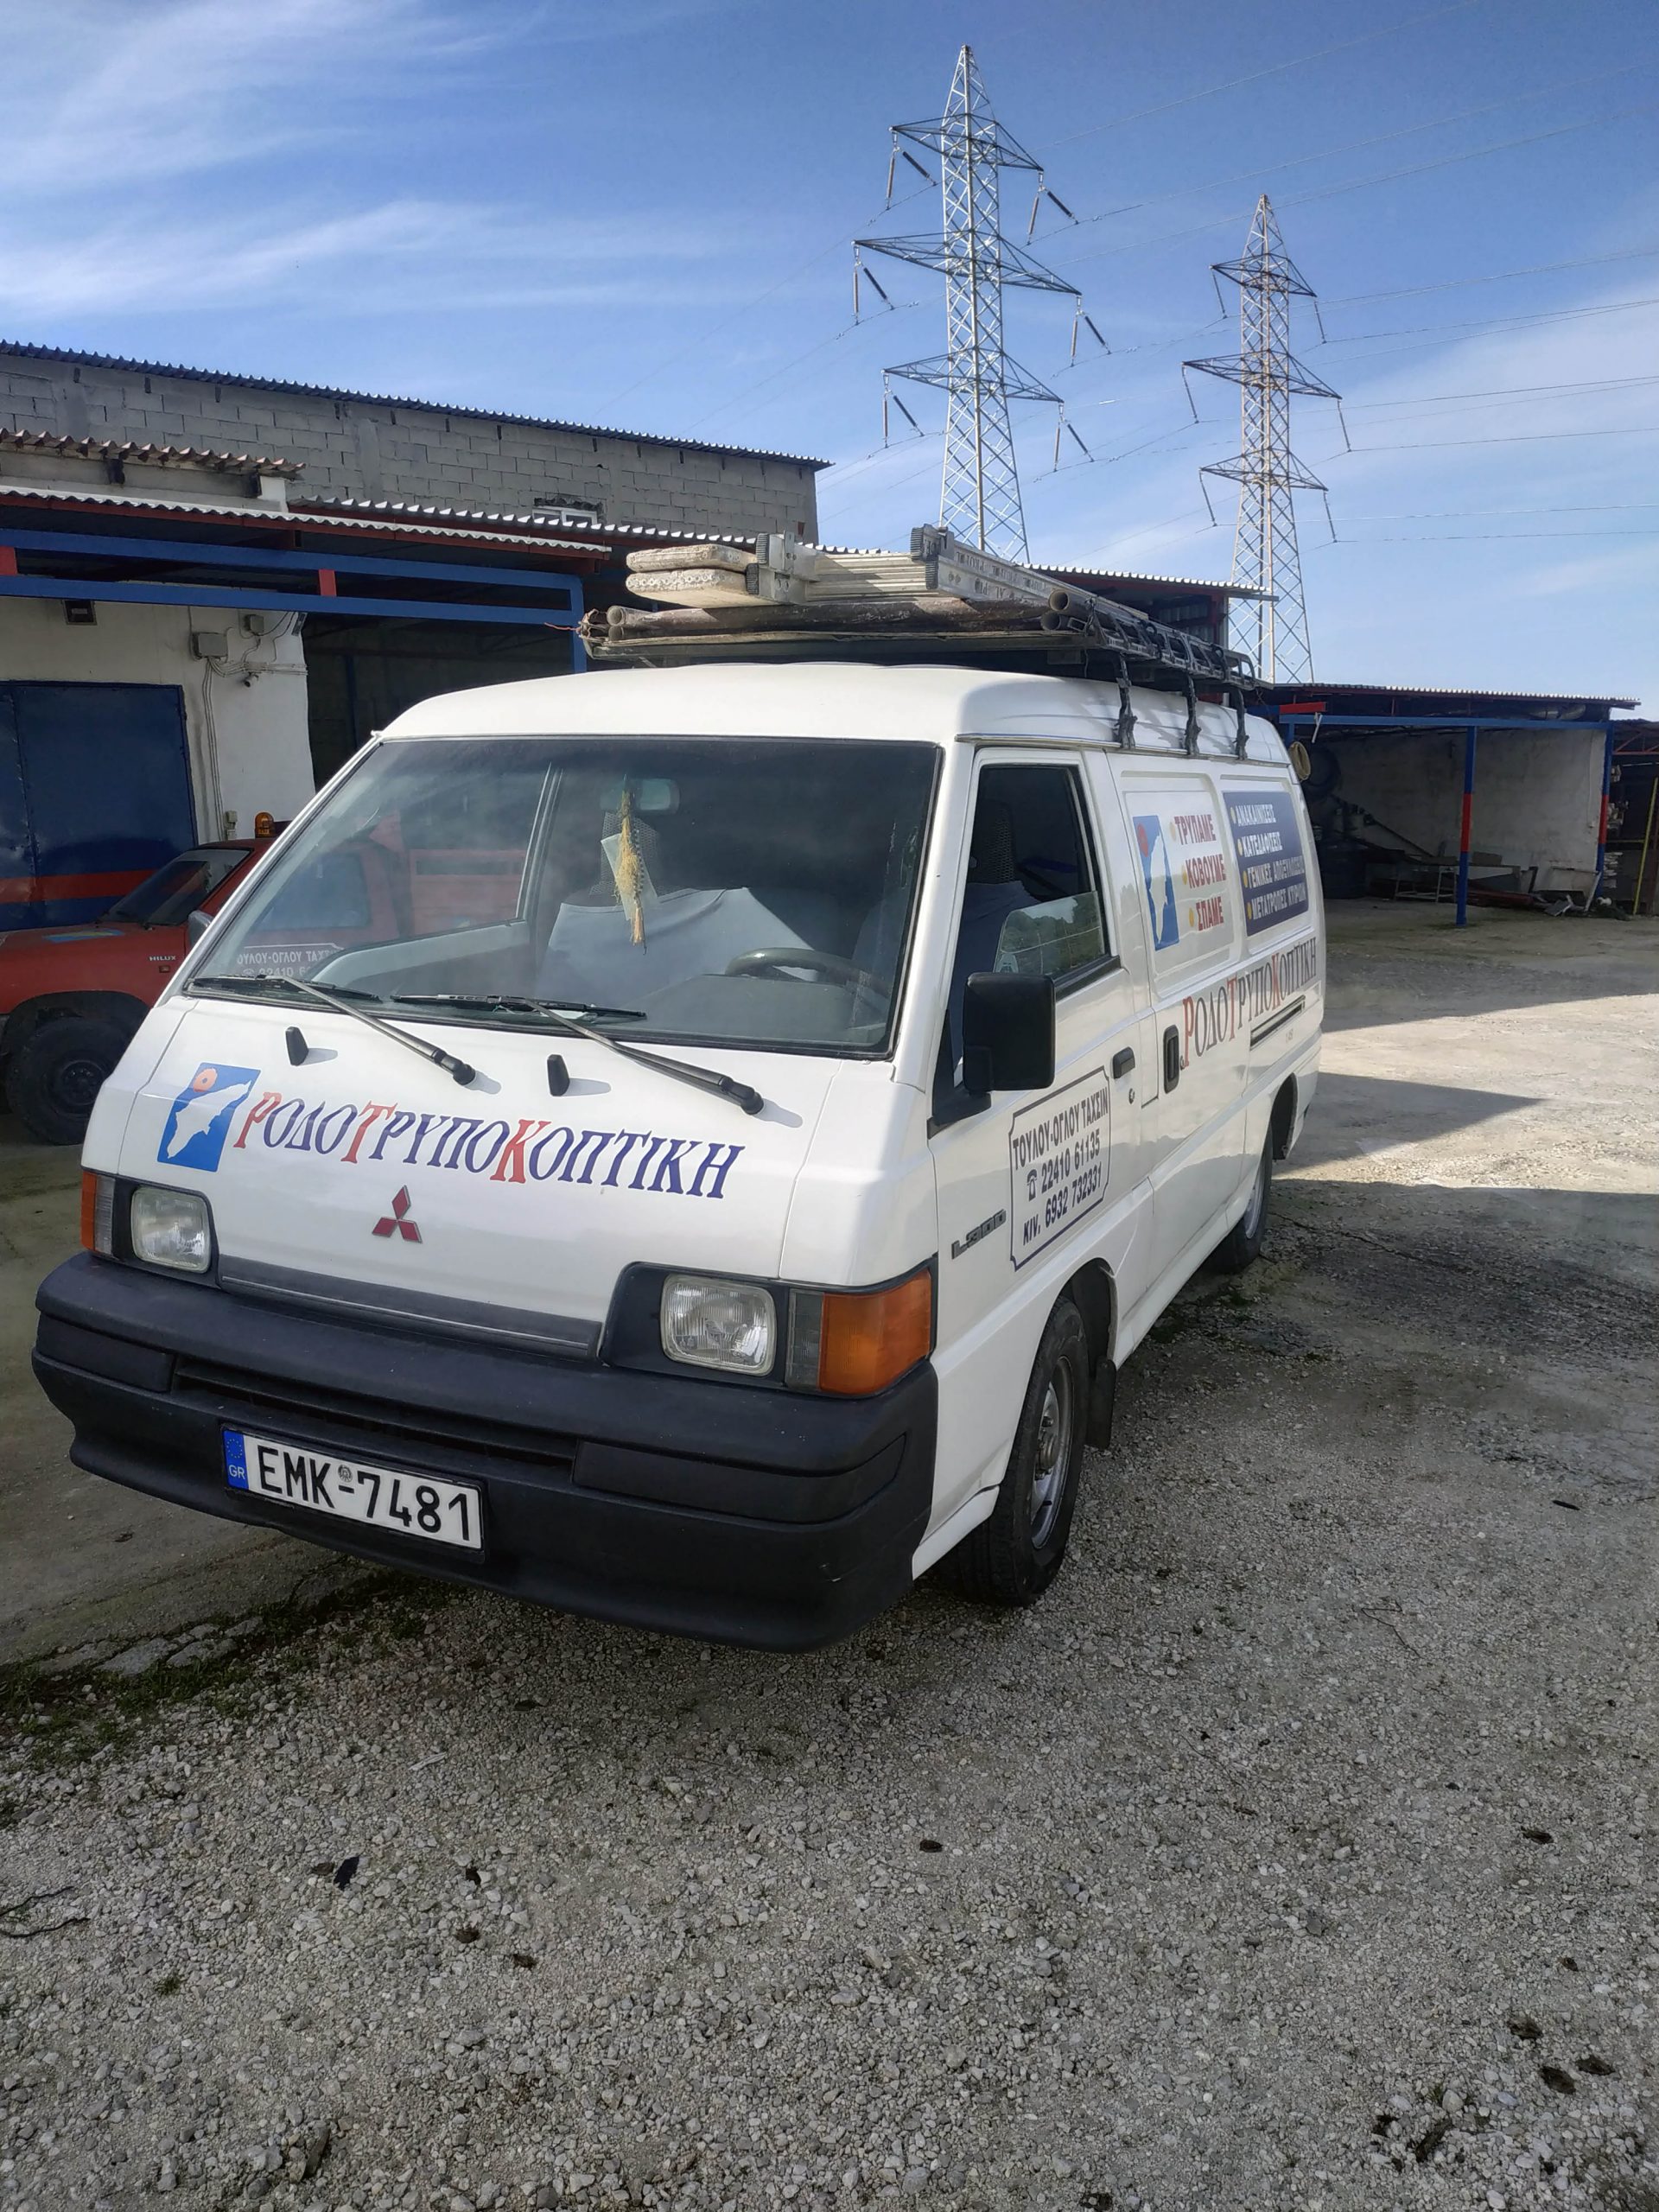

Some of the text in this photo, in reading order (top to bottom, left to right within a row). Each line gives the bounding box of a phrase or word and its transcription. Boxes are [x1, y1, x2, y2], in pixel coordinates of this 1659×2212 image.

[1173, 814, 1217, 845] ΤΡΥΠΑΜΕ
[1241, 831, 1283, 858] ΚΑΤΕΔΑΦΙΣΕΙΣ
[1185, 854, 1226, 889] ΚΟΒΟΥΜΕ
[1247, 862, 1273, 889] ΓΕΝΙΚΕΣ
[1195, 896, 1224, 931] ΣΠΑΜΕ
[1251, 888, 1287, 920] ΜΕΤΑΤΡΟΠΕΣ
[1182, 937, 1317, 1068] ΡΟΔΟΤΡΥΠΟΚΟΠΤΙΚΗ
[233, 1091, 745, 1198] ΡΟΔΟΤΡΥΠΟΚΟΠΤΙΚΗ
[1013, 1086, 1108, 1171] ΤΟΥΛΟΥ-ΟΓΛΟΥ ΤΑΧΣΙΝ
[1041, 1128, 1101, 1194] 22410 61135
[1046, 1186, 1069, 1228] 6932
[1072, 1161, 1103, 1207] 732331
[951, 1209, 1007, 1259] L300
[228, 1465, 245, 1479] GR
[257, 1444, 470, 1541] EMK-7481
